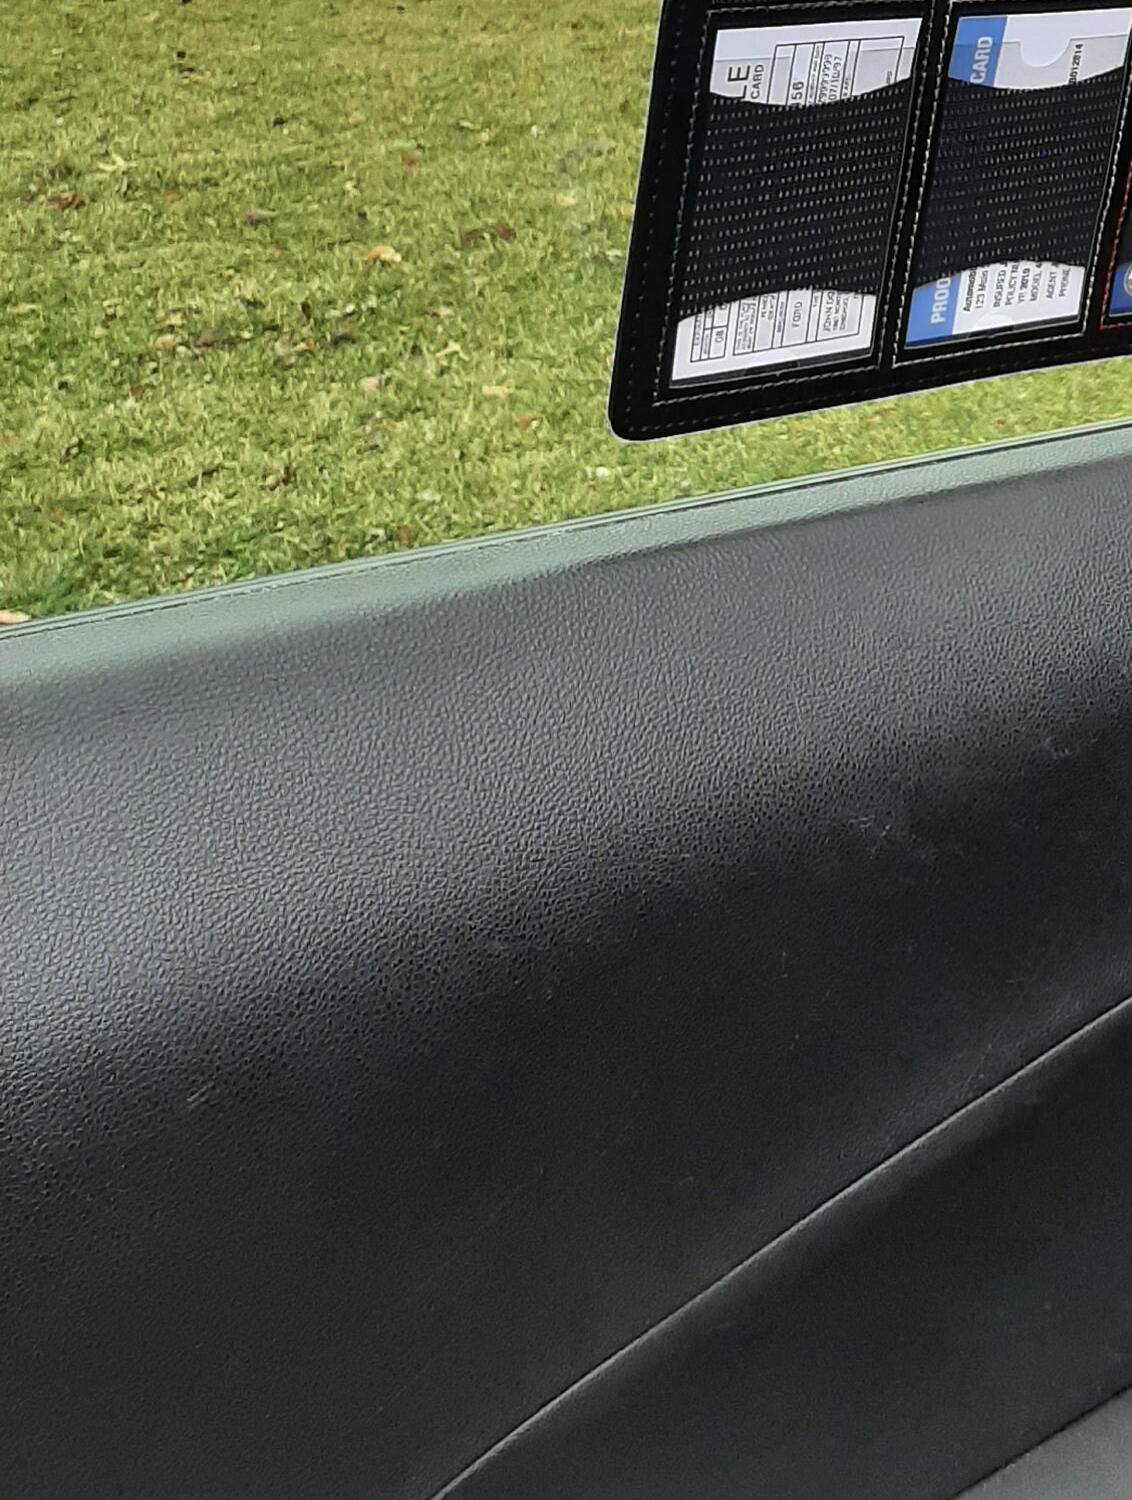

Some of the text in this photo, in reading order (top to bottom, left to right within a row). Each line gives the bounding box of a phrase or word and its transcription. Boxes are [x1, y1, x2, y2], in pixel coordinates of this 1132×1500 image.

[970, 36, 993, 83] CARD
[750, 64, 764, 100] CARD
[1046, 271, 1057, 299] AGENT
[1058, 268, 1071, 297] PHONE
